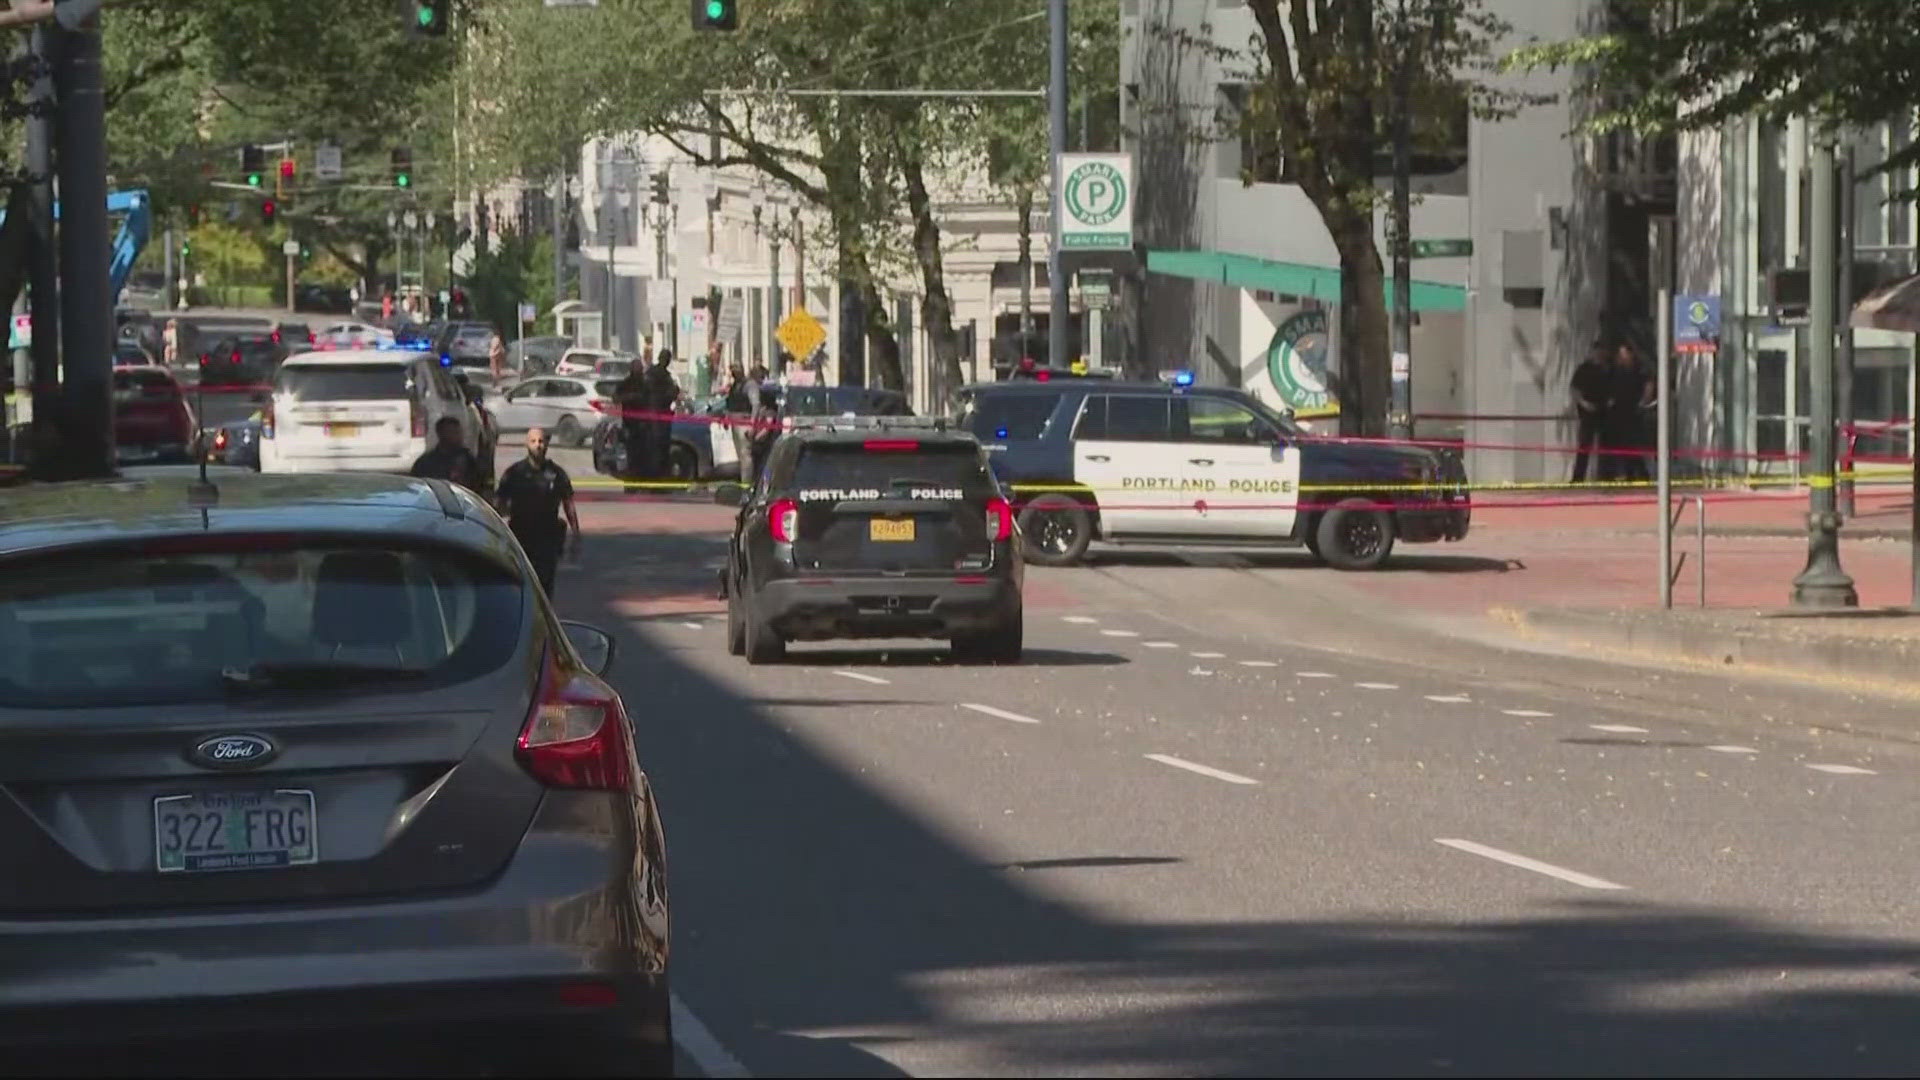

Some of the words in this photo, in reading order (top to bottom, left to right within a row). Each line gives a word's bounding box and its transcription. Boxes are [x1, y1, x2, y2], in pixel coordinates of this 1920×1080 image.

[1072, 163, 1118, 181] SMART
[1089, 181, 1106, 207] P
[1080, 210, 1115, 225] PARK
[1122, 477, 1216, 492] PORTLAND
[1229, 479, 1292, 493] POLICE
[800, 489, 880, 501] PORTLAND
[911, 489, 964, 500] POLICE
[214, 740, 254, 759] Ford
[163, 811, 224, 852] 322
[244, 808, 306, 848] FRG
